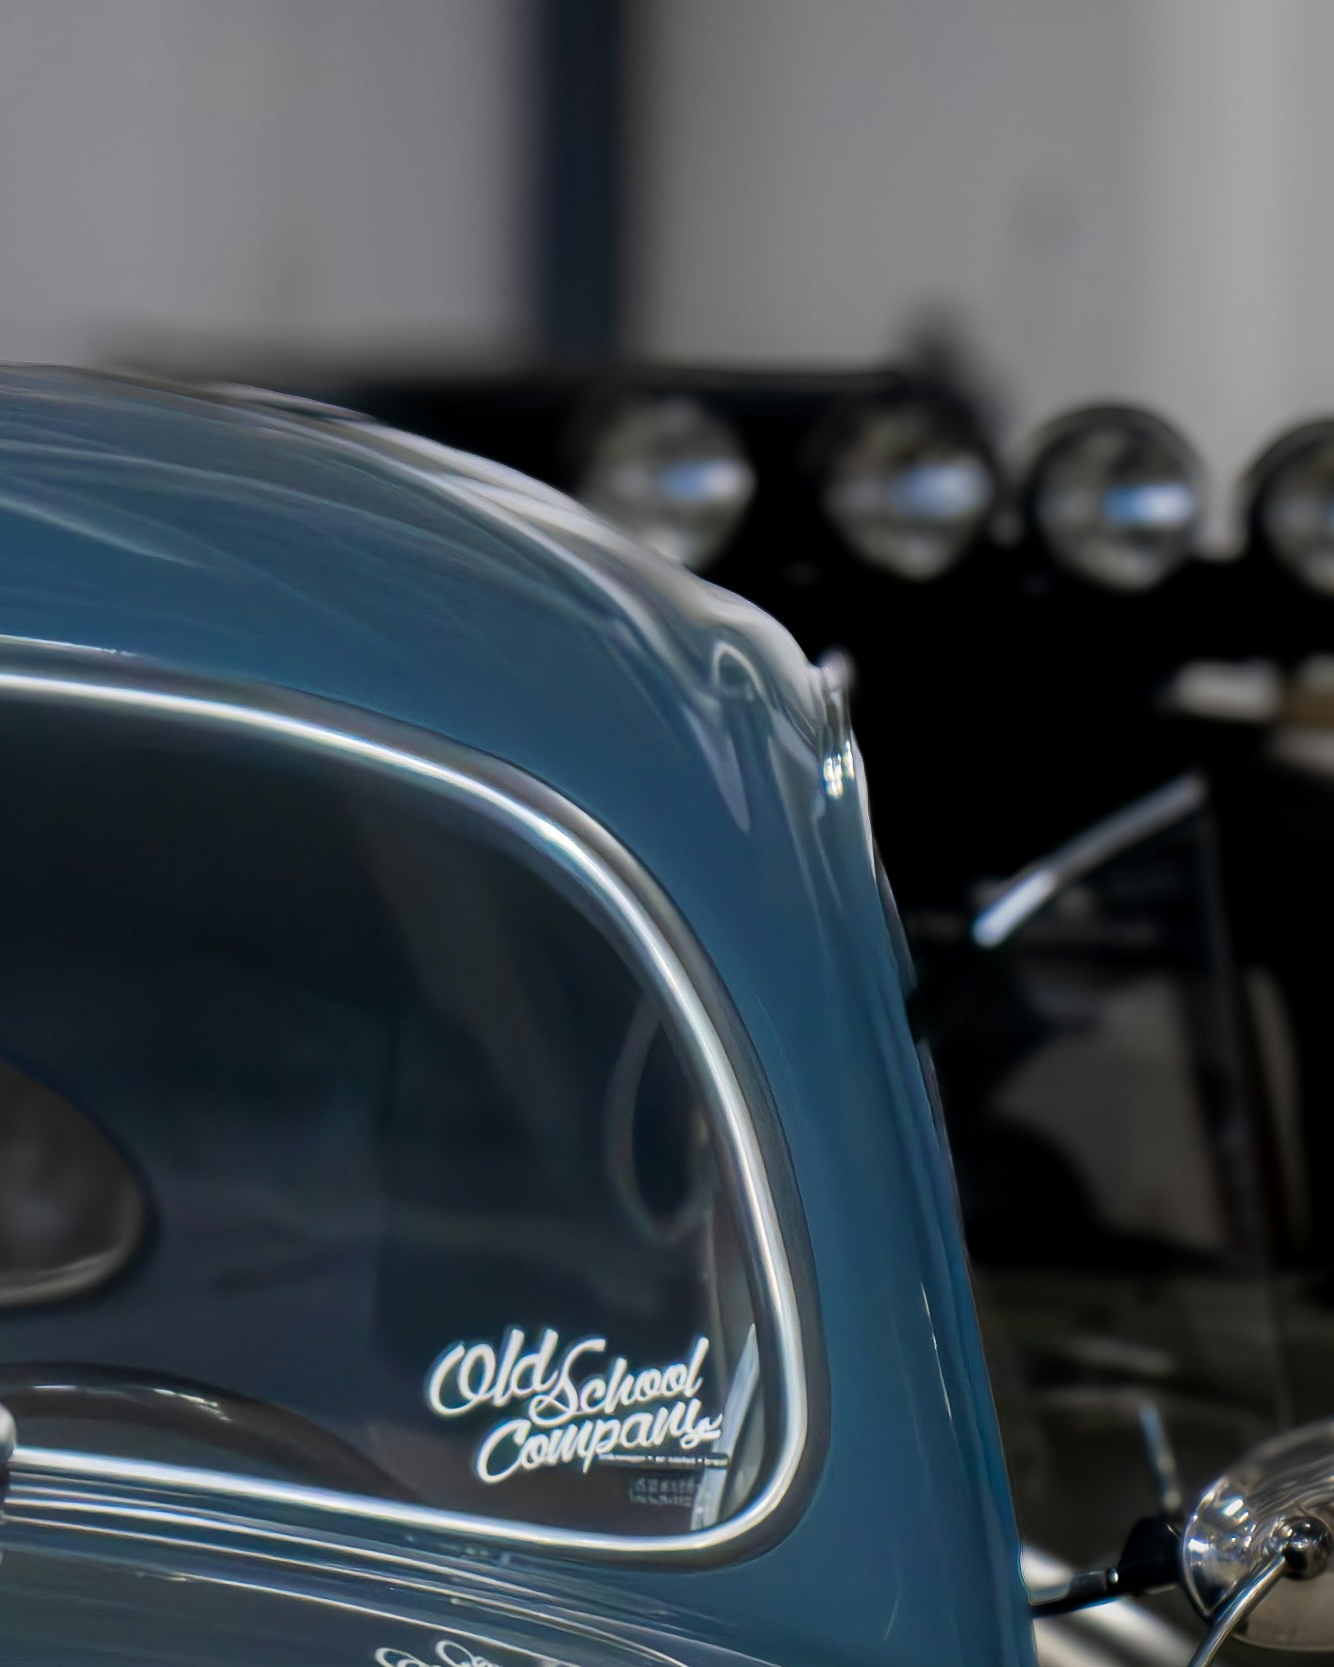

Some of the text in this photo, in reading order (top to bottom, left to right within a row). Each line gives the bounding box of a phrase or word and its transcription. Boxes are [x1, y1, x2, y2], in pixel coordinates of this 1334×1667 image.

[428, 1328, 710, 1427] Old School
[476, 1398, 724, 1484] Company
